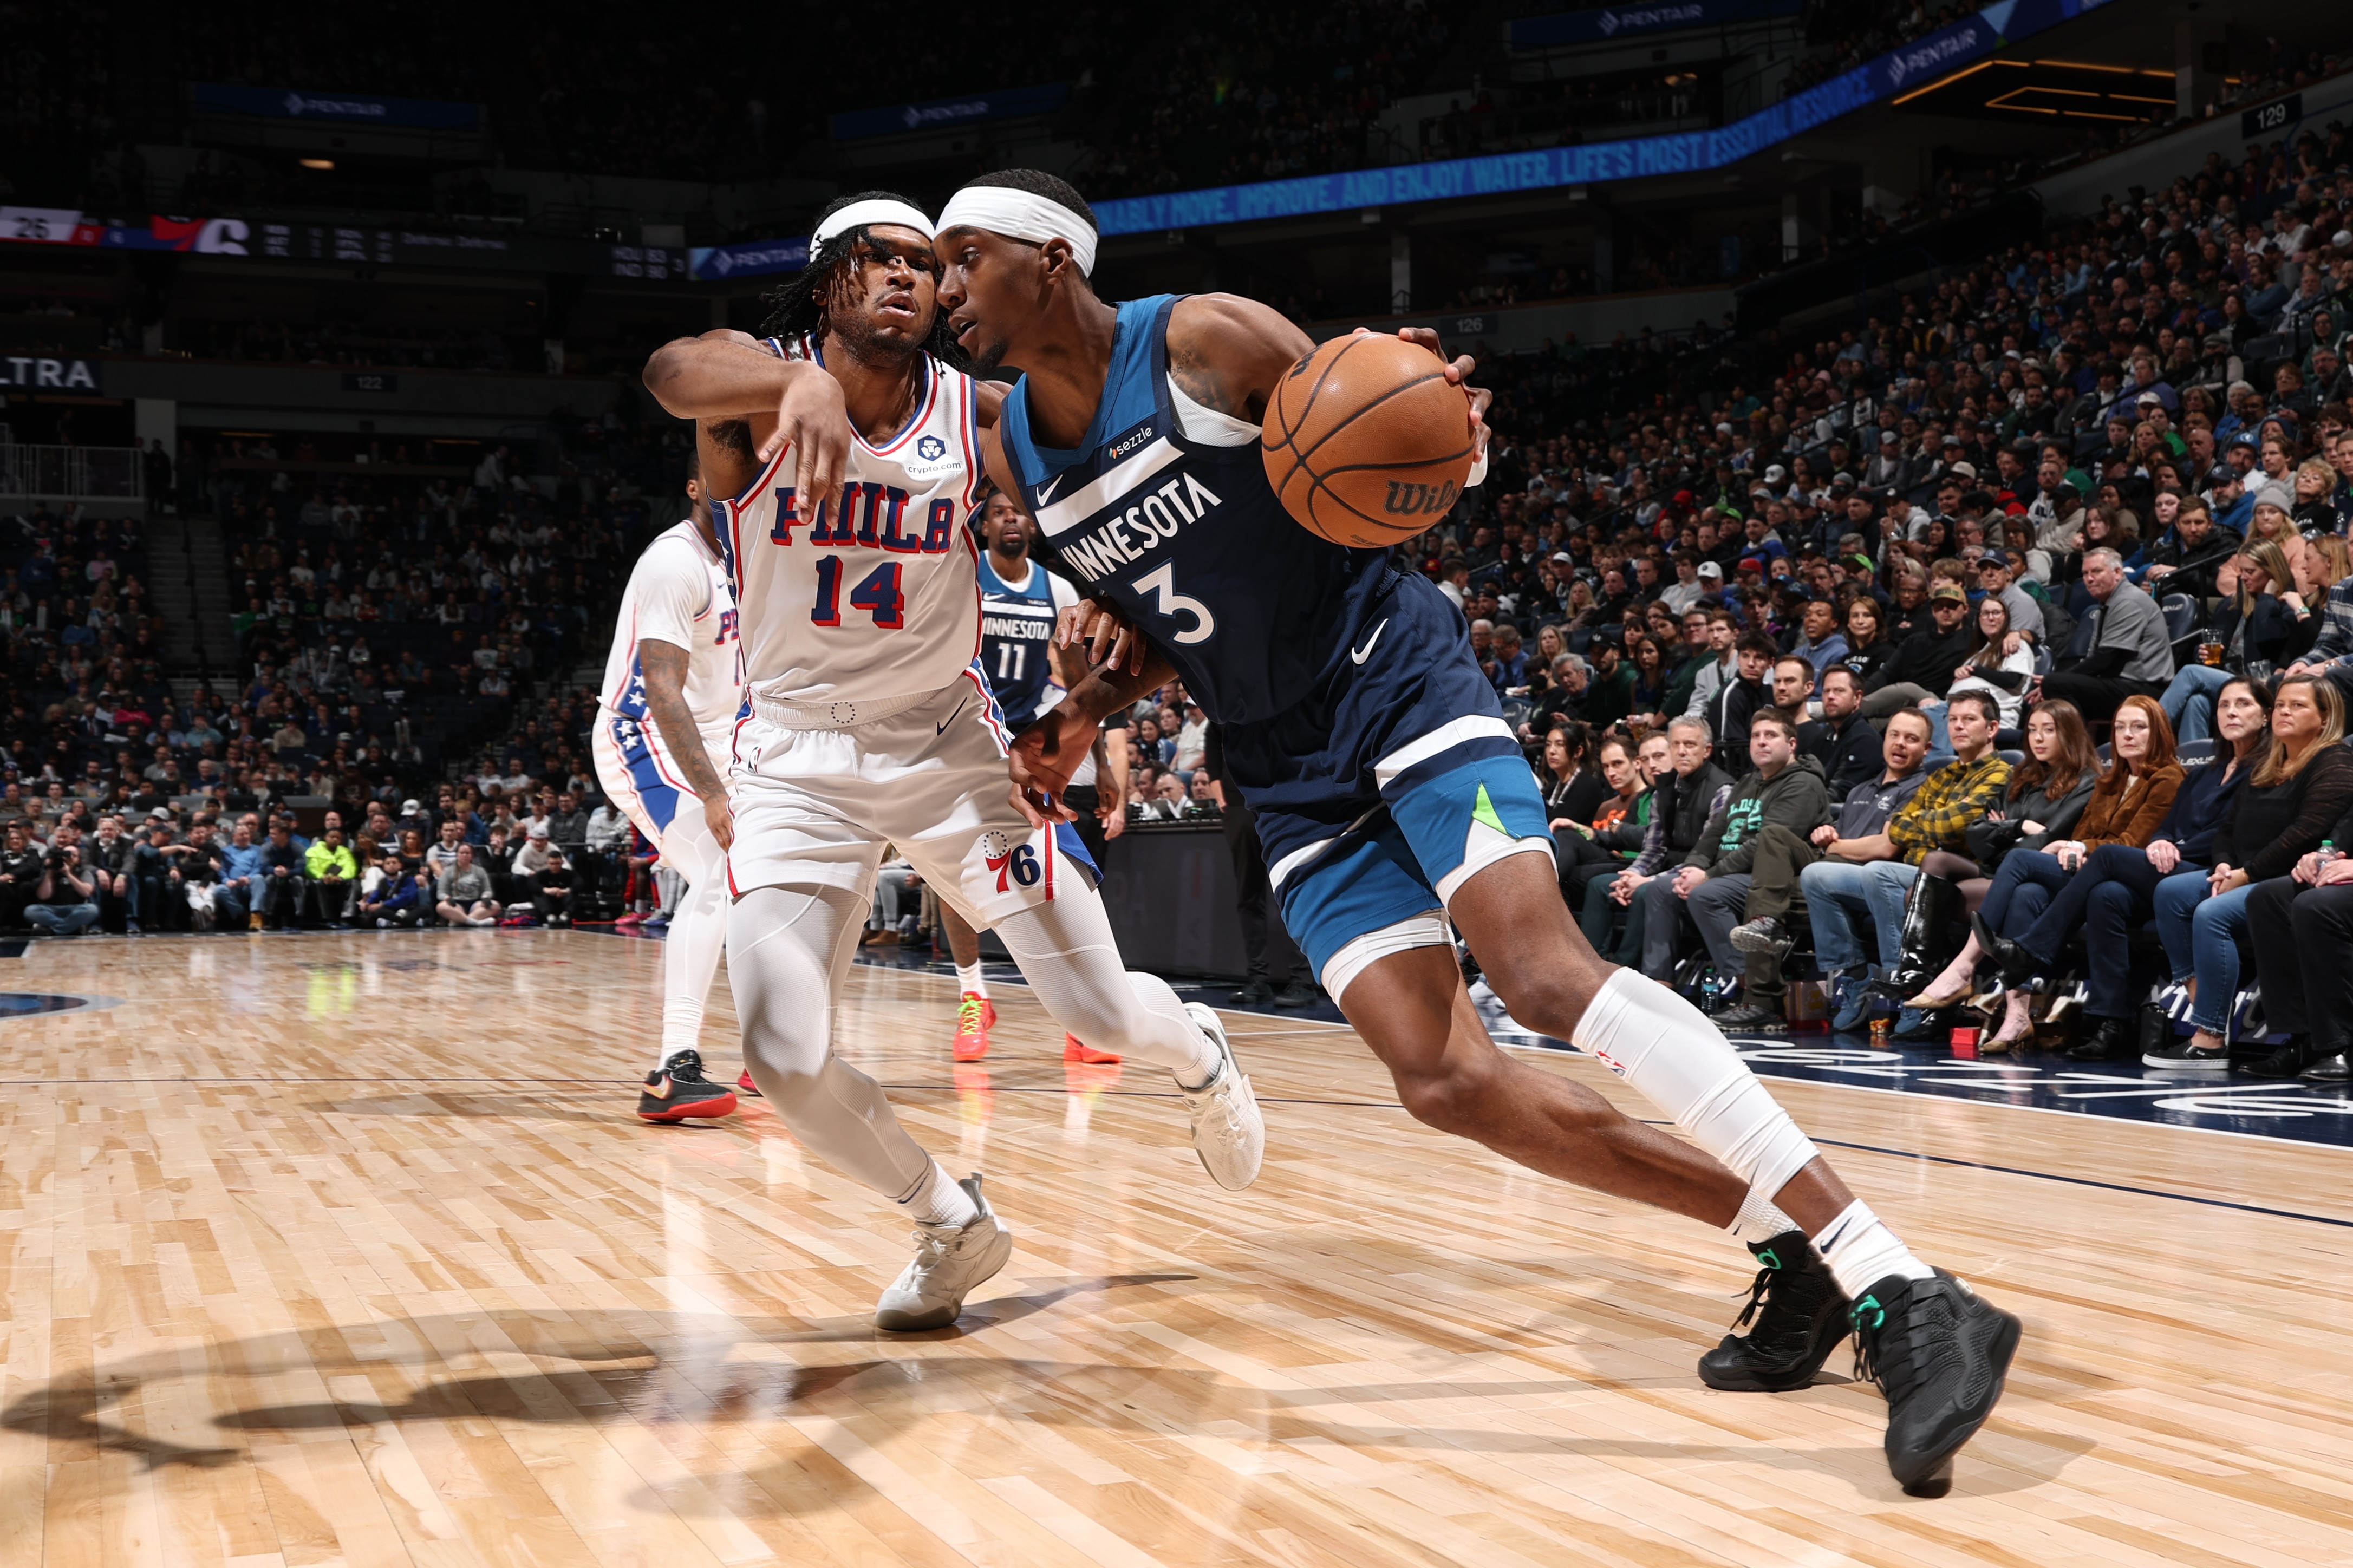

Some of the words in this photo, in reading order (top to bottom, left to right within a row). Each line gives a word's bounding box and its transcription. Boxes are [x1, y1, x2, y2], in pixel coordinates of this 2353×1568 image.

[1621, 4, 1703, 27] PENTAIR
[1906, 28, 1978, 73] PENTAIR
[2257, 103, 2286, 129] 129
[1342, 171, 1390, 207] AND
[1393, 162, 1466, 202] ENJOY
[1637, 134, 1704, 175] MOST
[1709, 105, 1789, 167] ESSENTIAL
[1456, 317, 1483, 334] 126
[356, 376, 383, 390] 122
[1116, 426, 1152, 456] sezzle
[908, 462, 961, 474] crypto.com
[1060, 472, 1222, 583] INNESOTA
[811, 555, 904, 630] 14
[1127, 558, 1218, 646] 3
[998, 642, 1026, 680] 11
[985, 844, 1041, 894] 76
